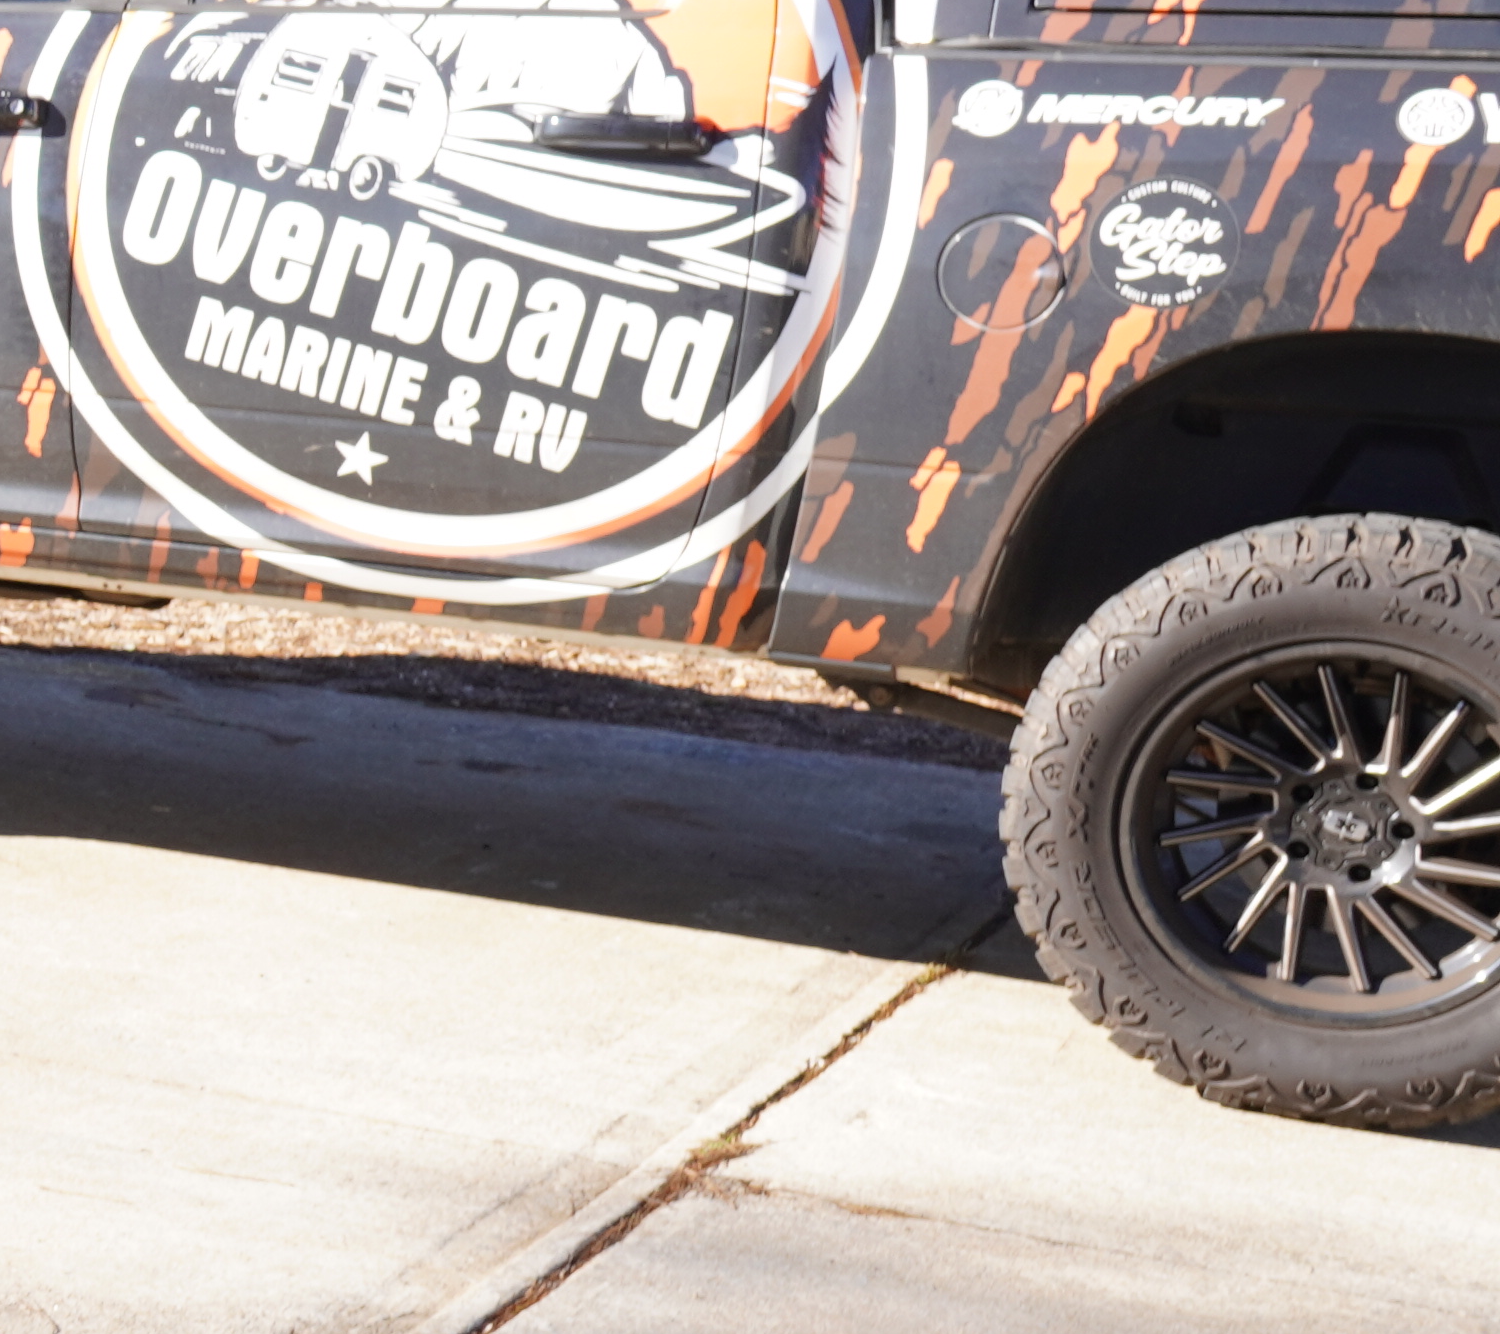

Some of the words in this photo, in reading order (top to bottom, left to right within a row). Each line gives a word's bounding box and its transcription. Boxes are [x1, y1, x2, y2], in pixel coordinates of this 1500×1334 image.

[1027, 93, 1285, 127] MERCURY
[1100, 203, 1224, 252] Gator
[1115, 238, 1227, 287] Step
[122, 150, 733, 430] Overboard
[1151, 293, 1171, 307] FOR
[1175, 288, 1196, 304] YOU
[184, 295, 427, 427] MARINE
[433, 375, 483, 447] &
[494, 392, 587, 473] RV
